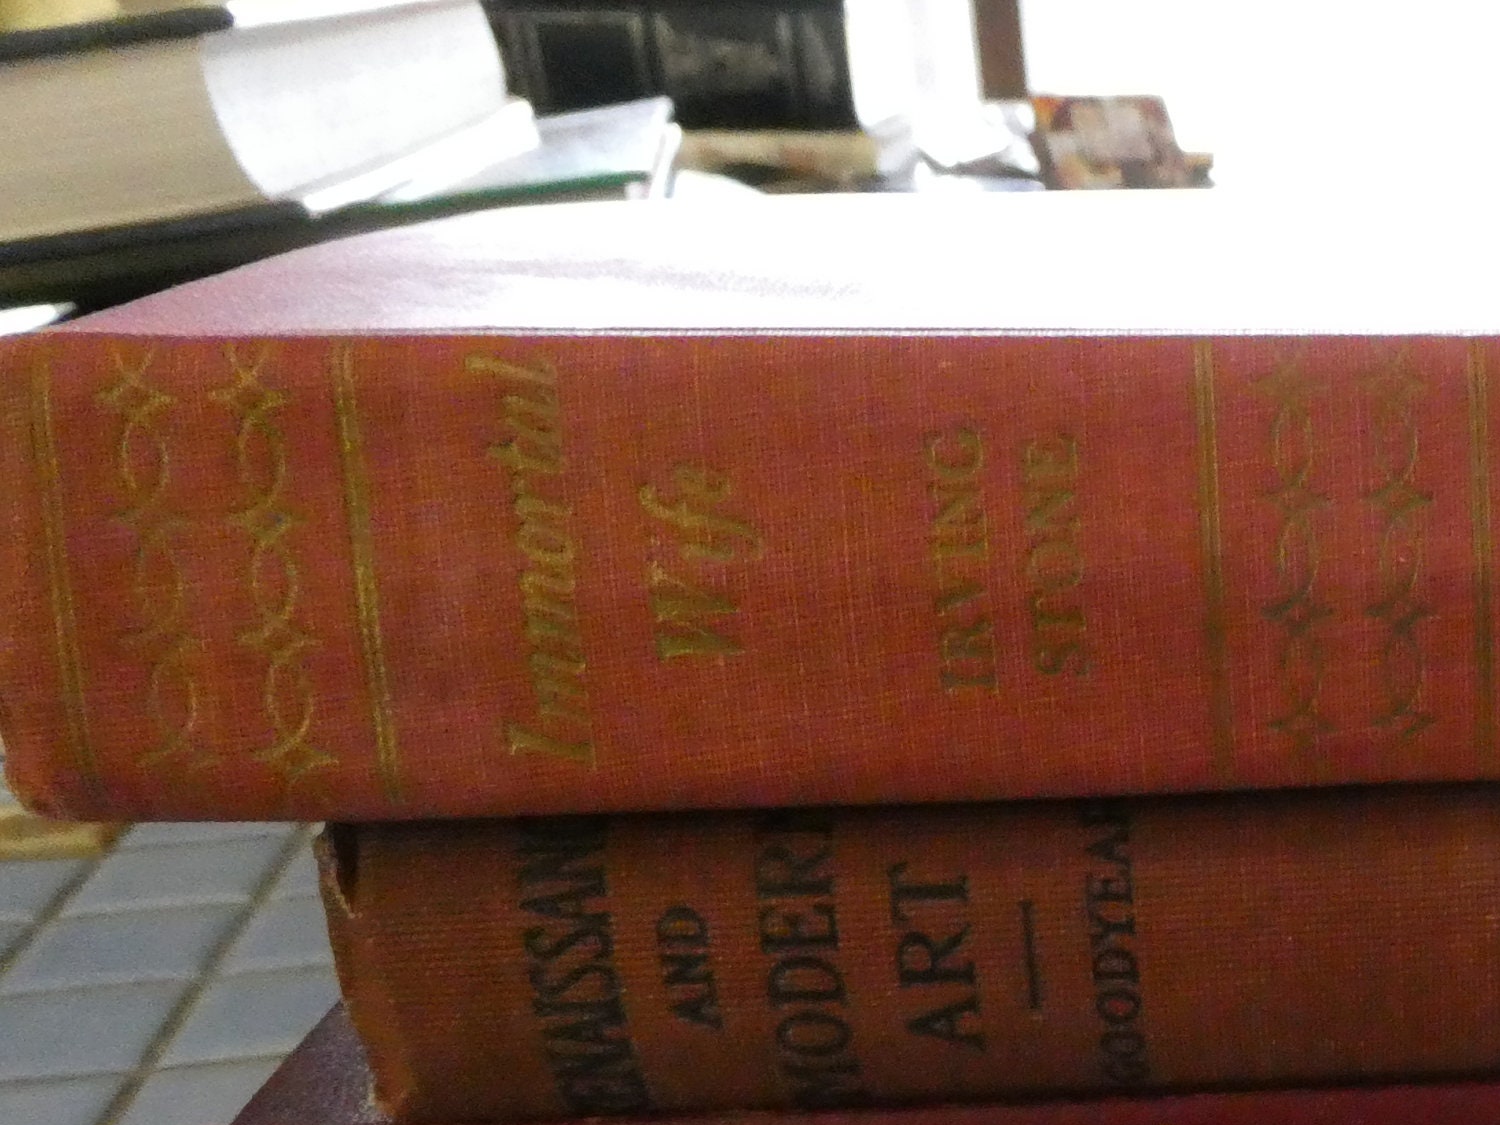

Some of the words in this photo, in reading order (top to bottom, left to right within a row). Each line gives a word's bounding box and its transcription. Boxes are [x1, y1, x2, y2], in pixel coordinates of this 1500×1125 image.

[463, 352, 596, 770] Immortal
[638, 460, 763, 663] Wife
[923, 428, 996, 693] IRVING
[1024, 431, 1091, 677] STONE
[656, 904, 724, 1031] AND
[888, 861, 986, 1053] ART
